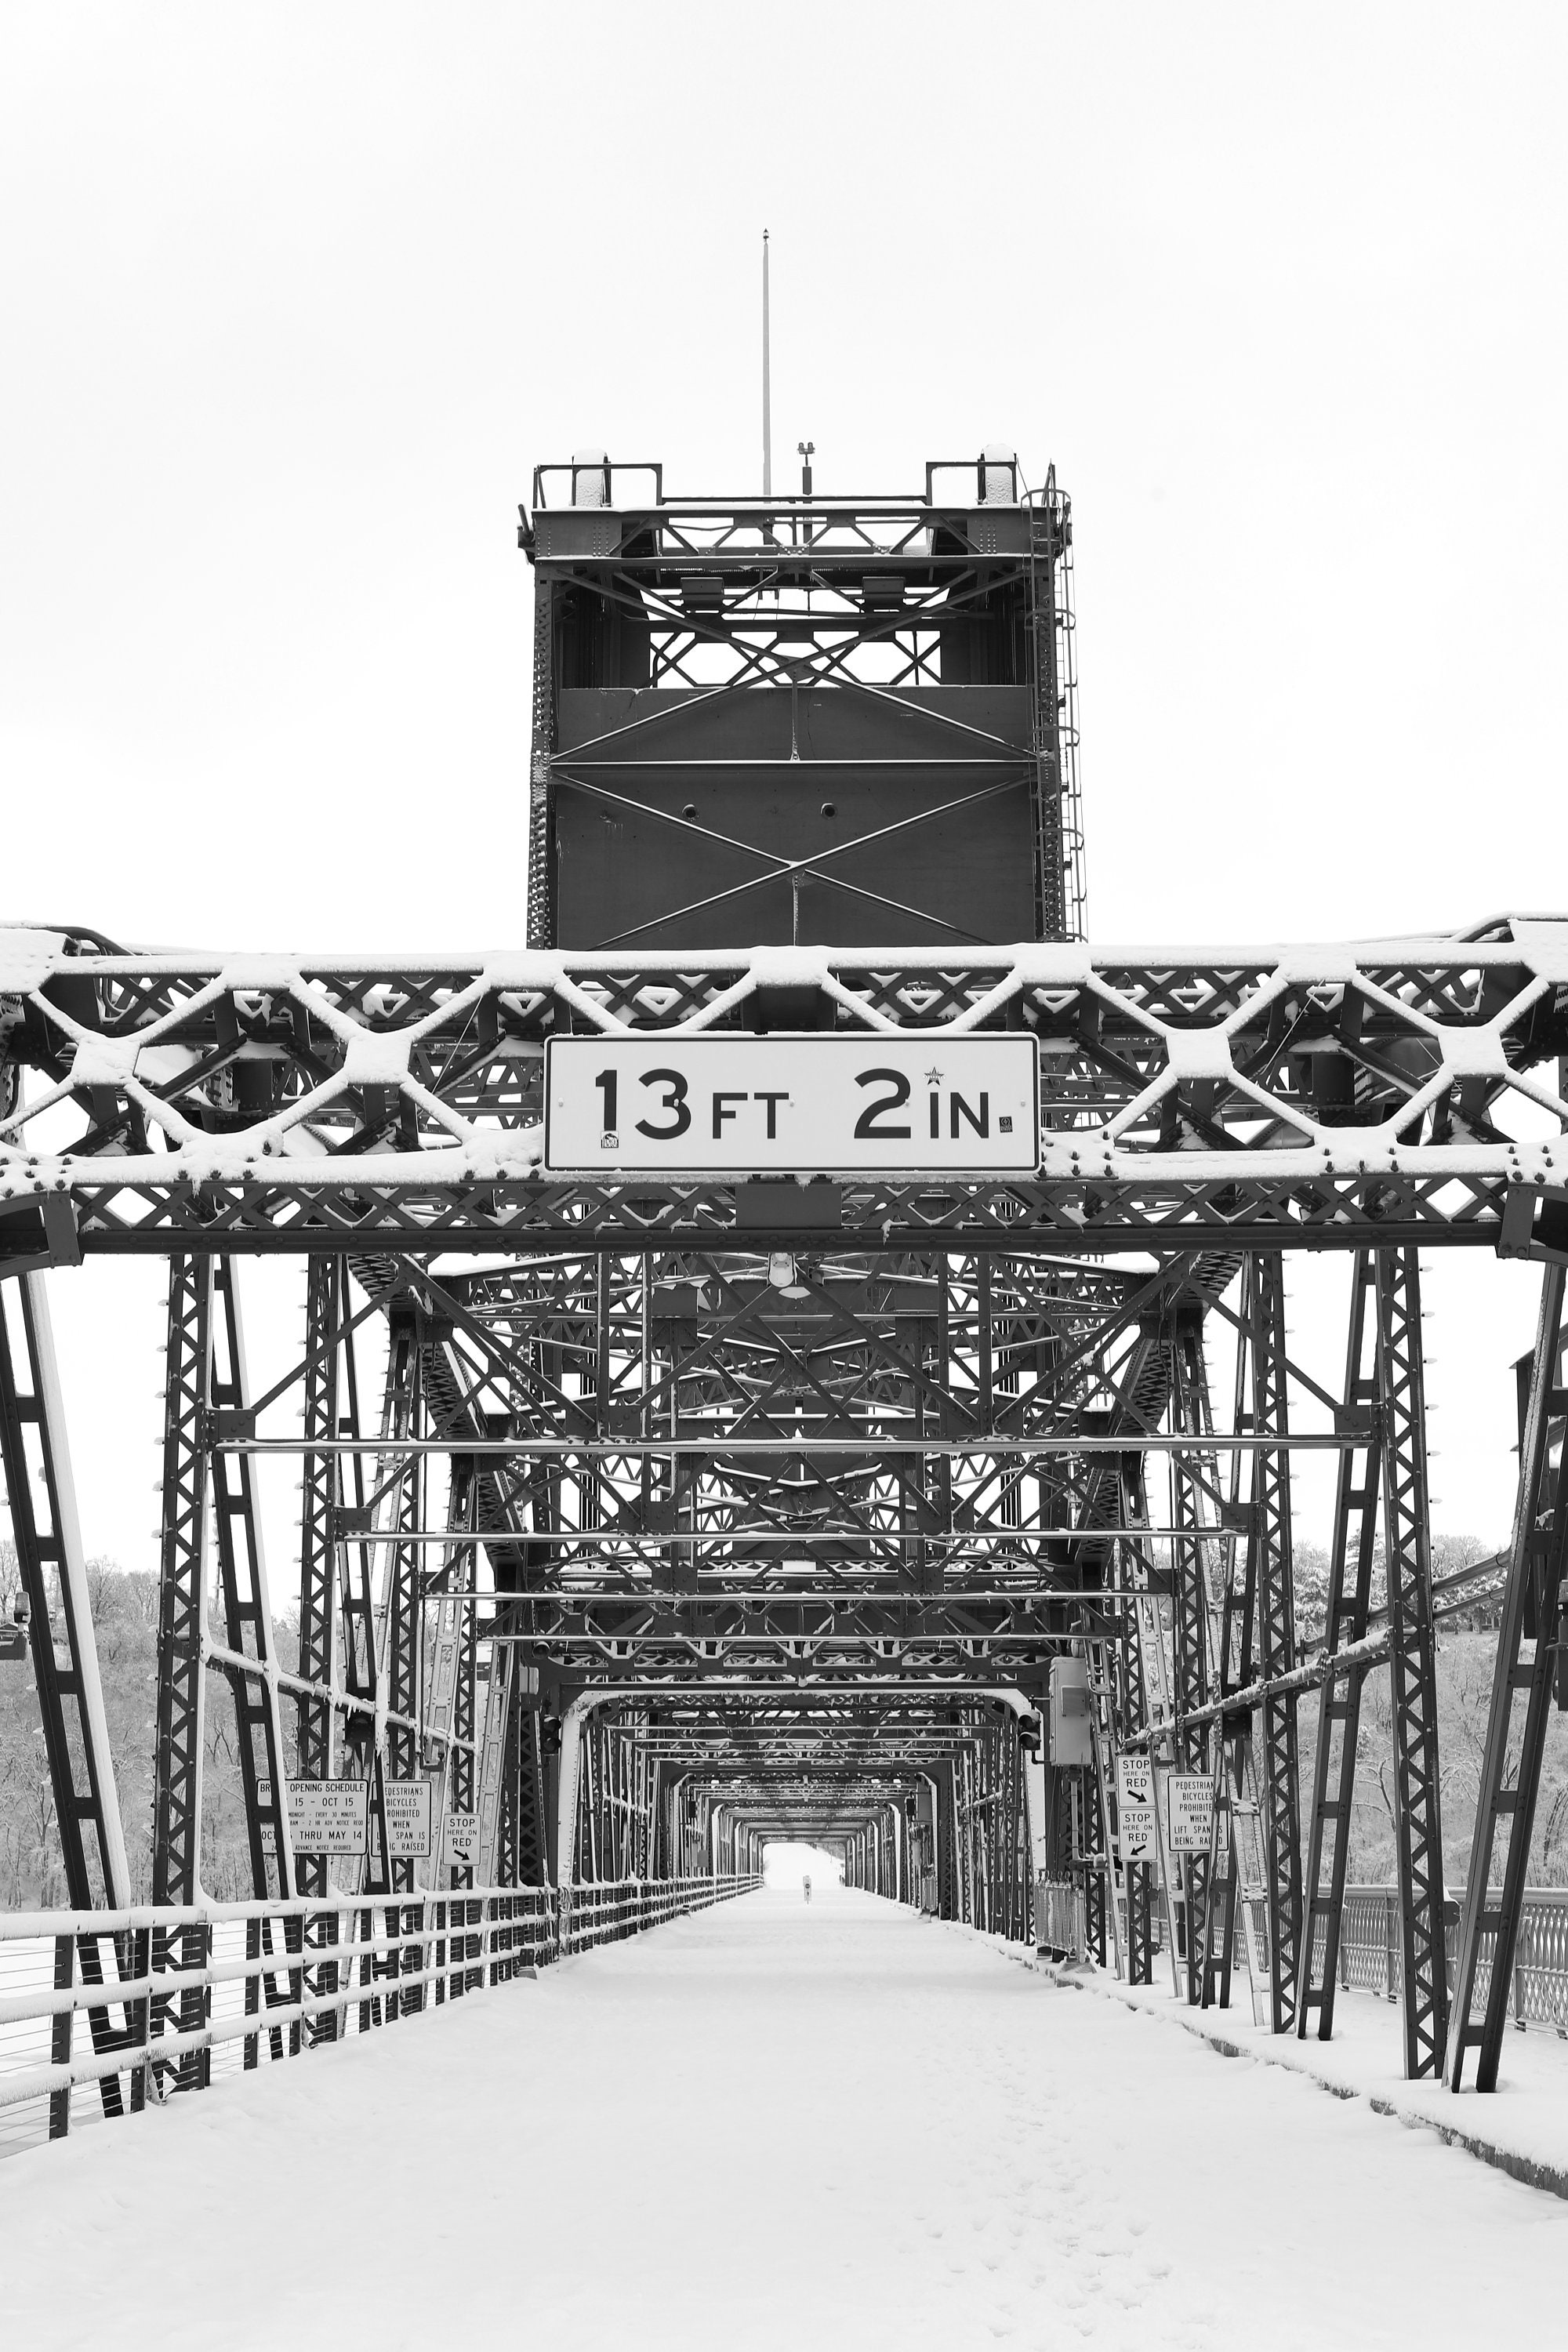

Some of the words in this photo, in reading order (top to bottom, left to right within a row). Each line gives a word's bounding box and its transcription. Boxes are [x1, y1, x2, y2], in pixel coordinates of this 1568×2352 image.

[1123, 1760, 1150, 1769] STOP
[1127, 1778, 1147, 1787] RED
[290, 1784, 322, 1792] OPENING
[385, 1788, 423, 1796] EDESTRIANS
[1183, 1792, 1214, 1802] BICYCLES
[296, 1798, 303, 1806] 15
[322, 1798, 337, 1806] OCT
[346, 1798, 353, 1806] 15
[1179, 1803, 1213, 1812] PROHIBITE
[1125, 1813, 1150, 1822] STOP
[1194, 1826, 1211, 1835] SPAN
[452, 1838, 471, 1846] RED
[1129, 1833, 1147, 1842] RED
[1175, 1836, 1193, 1845] BEING
[402, 1842, 424, 1850] RAISED
